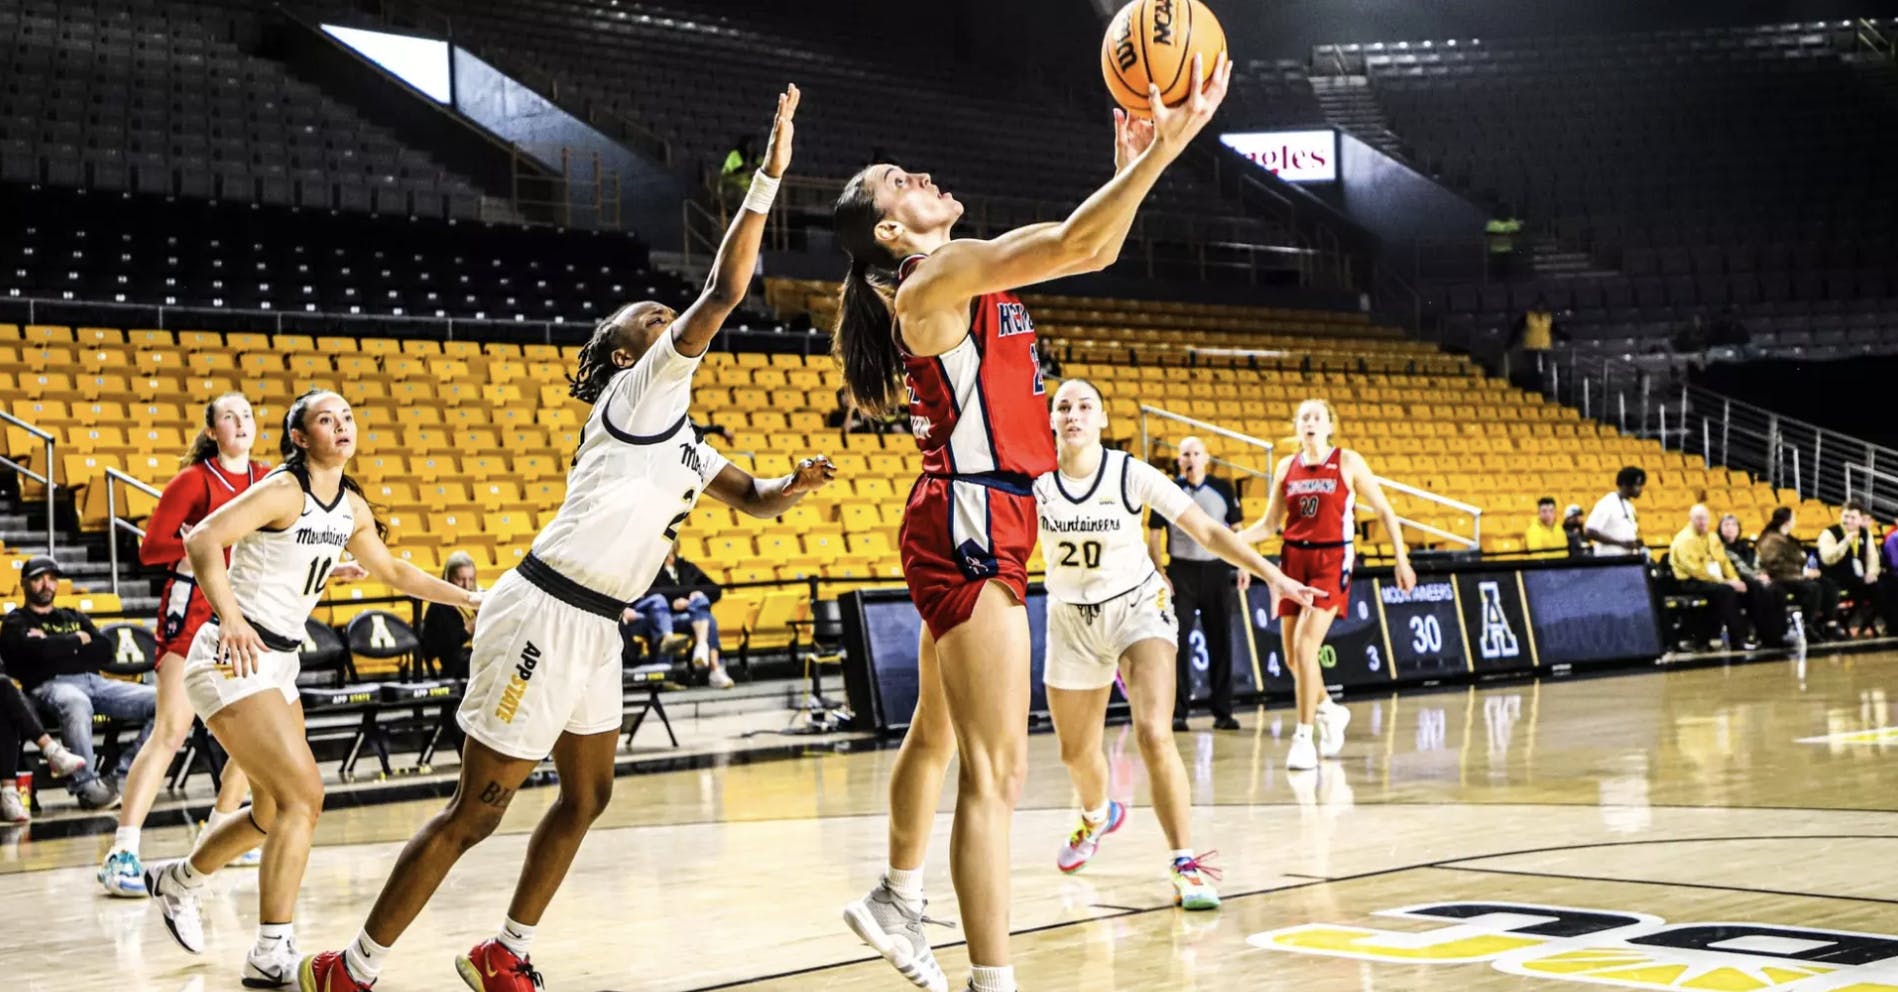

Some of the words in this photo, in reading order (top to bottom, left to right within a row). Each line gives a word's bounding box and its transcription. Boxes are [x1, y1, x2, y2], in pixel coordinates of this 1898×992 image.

[1058, 540, 1102, 569] 20
[303, 556, 332, 595] 10
[1256, 608, 1268, 628] 0
[1357, 600, 1369, 620] 0
[1478, 581, 1519, 659] A
[1409, 614, 1442, 654] 30
[1188, 628, 1210, 671] 3
[1266, 651, 1281, 677] 4
[1365, 645, 1381, 671] 3
